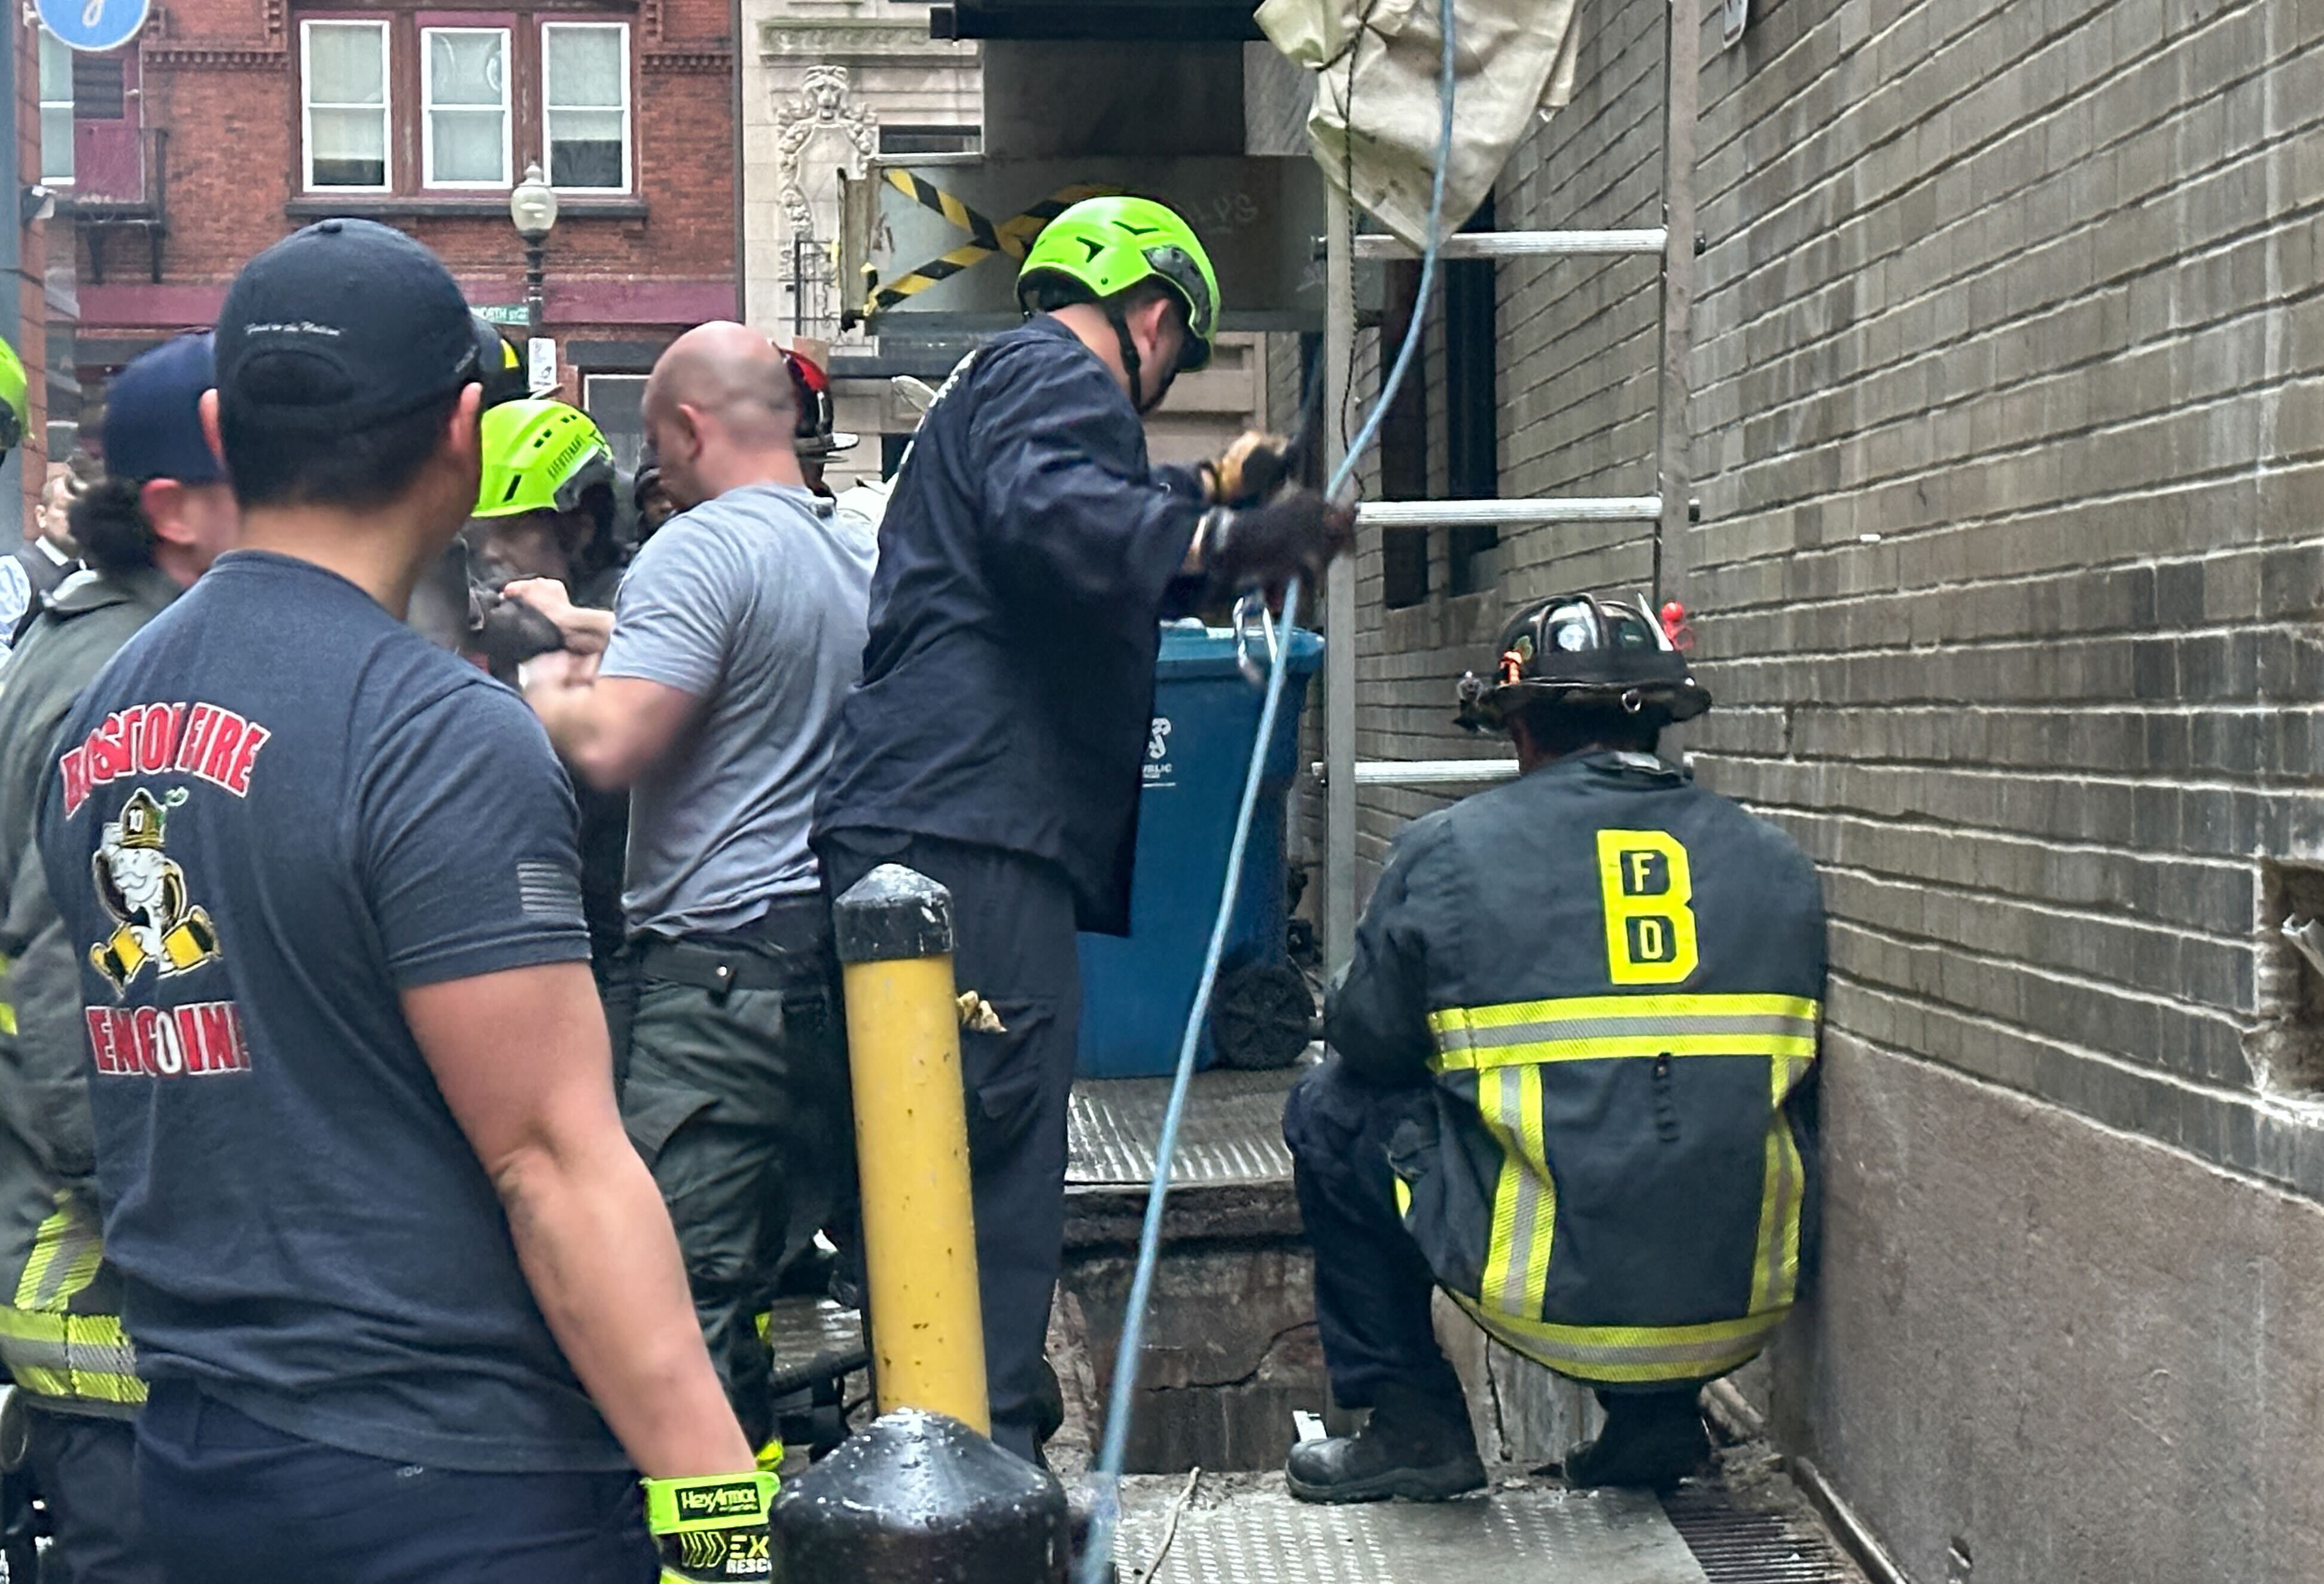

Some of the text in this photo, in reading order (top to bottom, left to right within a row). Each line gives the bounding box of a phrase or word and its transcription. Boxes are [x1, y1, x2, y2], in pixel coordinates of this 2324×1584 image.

[175, 701, 272, 798] FIRE
[129, 809, 144, 833] 10
[1631, 852, 1655, 892] F
[1597, 828, 1699, 985] B
